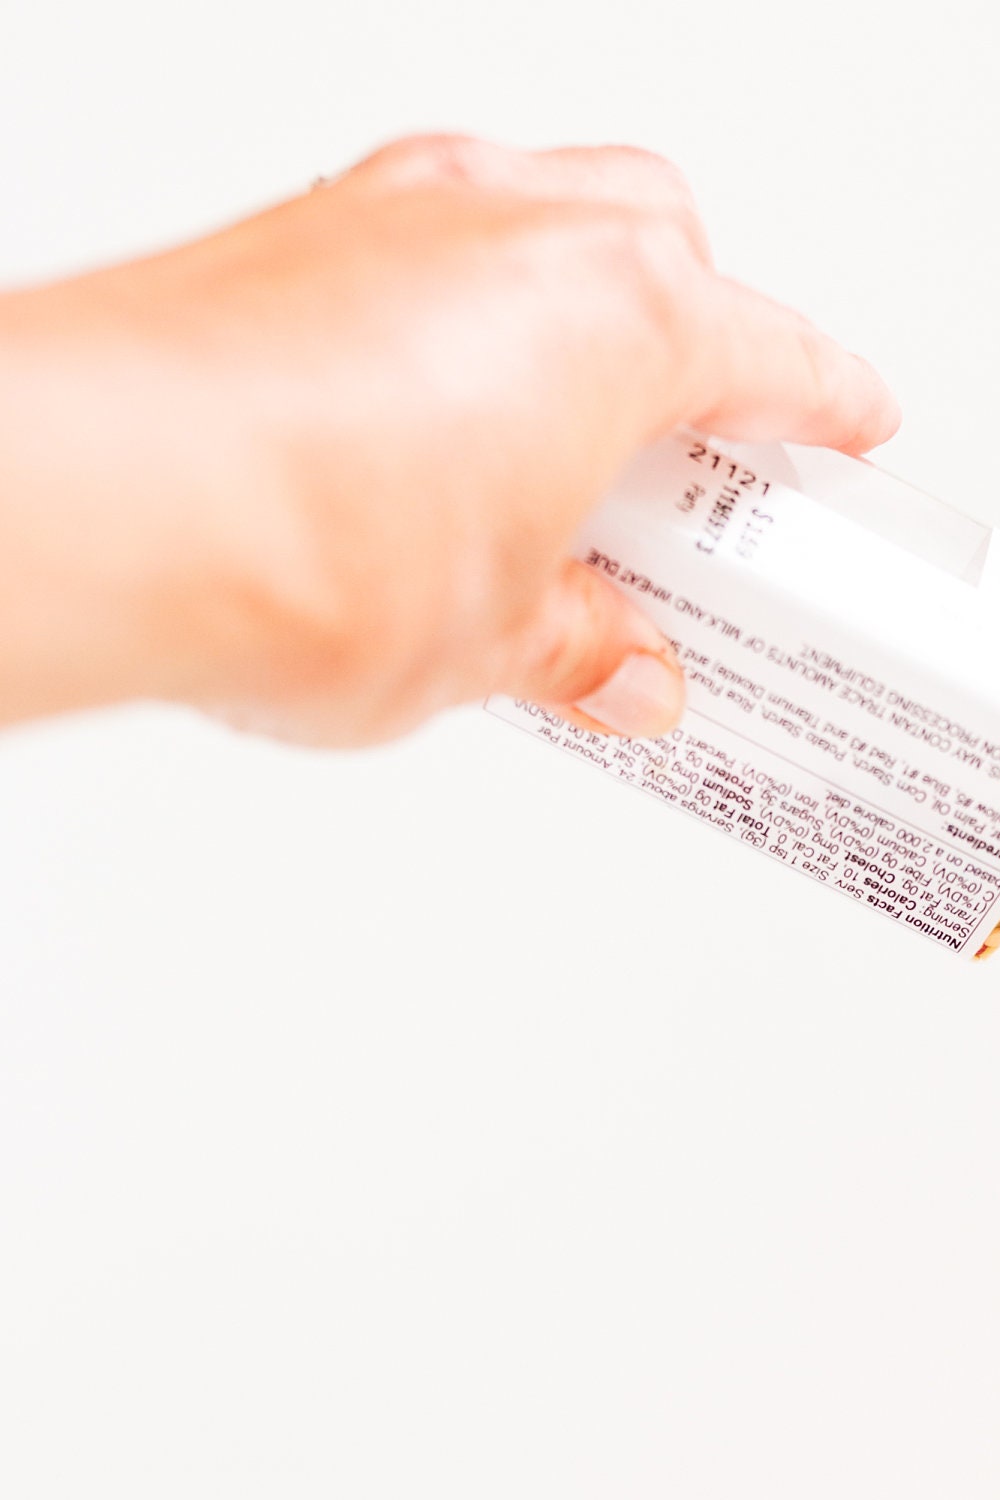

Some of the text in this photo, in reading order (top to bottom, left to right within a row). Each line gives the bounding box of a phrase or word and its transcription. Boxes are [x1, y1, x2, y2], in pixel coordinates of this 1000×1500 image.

[688, 442, 770, 496] 21121
[586, 550, 619, 576] DUE
[619, 570, 671, 601] WHEAT
[675, 599, 705, 620] AND
[710, 617, 741, 640] MILK
[743, 637, 765, 652] OF
[684, 648, 709, 665] and
[767, 647, 838, 691] AMOUNTS
[713, 663, 765, 699] Dioxide)
[726, 690, 755, 713] Rice
[768, 694, 818, 729] Titanium
[839, 685, 886, 719] TRACE
[823, 723, 849, 739] and
[887, 692, 980, 748] PROCESSING
[890, 712, 952, 750] CONTAIN
[537, 726, 561, 744] Per
[585, 732, 608, 753] Fat
[850, 738, 867, 752] #3
[562, 738, 613, 769] Amount
[685, 736, 736, 769] Percent
[805, 732, 847, 762] Potato
[868, 747, 897, 769] Red
[955, 749, 982, 769] MAY
[671, 761, 700, 784] 0mg
[706, 763, 754, 795] Protein
[694, 789, 712, 806] 0g
[702, 778, 754, 811] Sodium
[896, 780, 927, 804] Corn
[922, 775, 951, 797] Blue
[713, 800, 736, 819] Fat
[794, 792, 820, 812] Iron
[931, 796, 951, 816] Oil,
[680, 800, 734, 833] Servings
[736, 813, 770, 838] Total
[779, 801, 824, 831] Sugars
[853, 805, 895, 831] calorie
[953, 810, 986, 834] Palm
[768, 844, 788, 860] tsp
[791, 839, 815, 859] Cal.
[811, 832, 840, 855] 0mg
[876, 835, 927, 868] Calcium
[896, 828, 934, 854] 2,000
[935, 847, 945, 856] a
[790, 856, 798, 865] 1
[802, 861, 830, 881] Size
[816, 853, 839, 871] Fat
[844, 850, 896, 884] Cholest.
[881, 852, 898, 869] 0g
[946, 853, 964, 867] on
[899, 865, 933, 887] Fiber
[863, 877, 917, 911] Calories
[919, 890, 942, 908] Fat
[982, 890, 995, 903] C
[866, 894, 903, 919] Facts
[943, 903, 977, 927] Trans
[905, 914, 962, 949] Nutrition
[919, 906, 970, 938] Serving:
